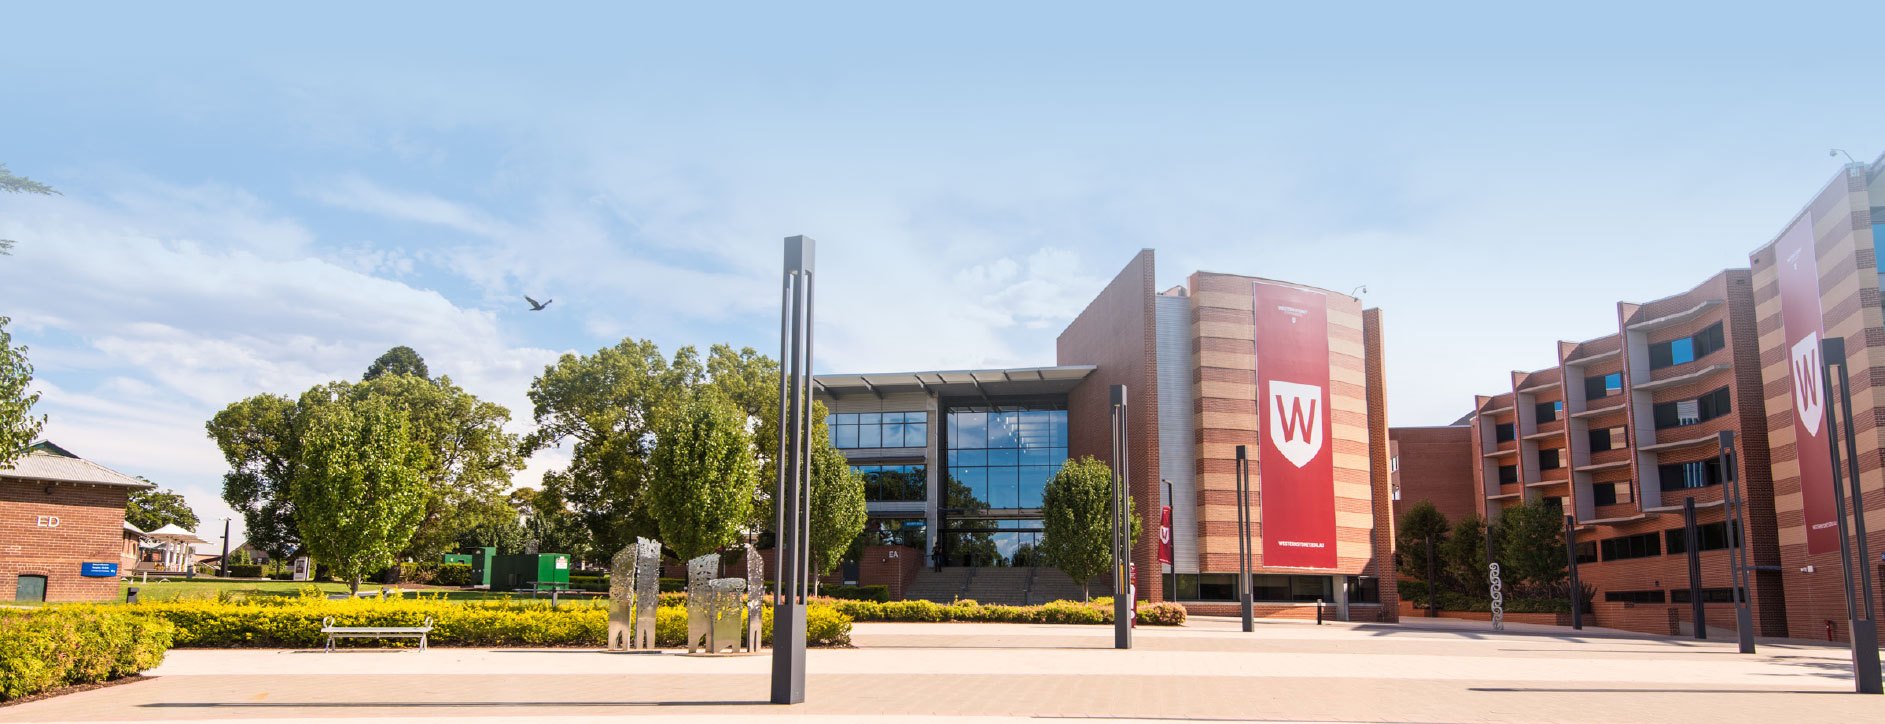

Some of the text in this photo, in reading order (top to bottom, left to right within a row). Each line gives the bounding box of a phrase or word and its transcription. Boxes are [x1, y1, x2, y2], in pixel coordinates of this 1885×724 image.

[1796, 349, 1817, 411] W
[1276, 395, 1316, 444] W
[37, 515, 60, 527] ED
[889, 550, 899, 558] EA
